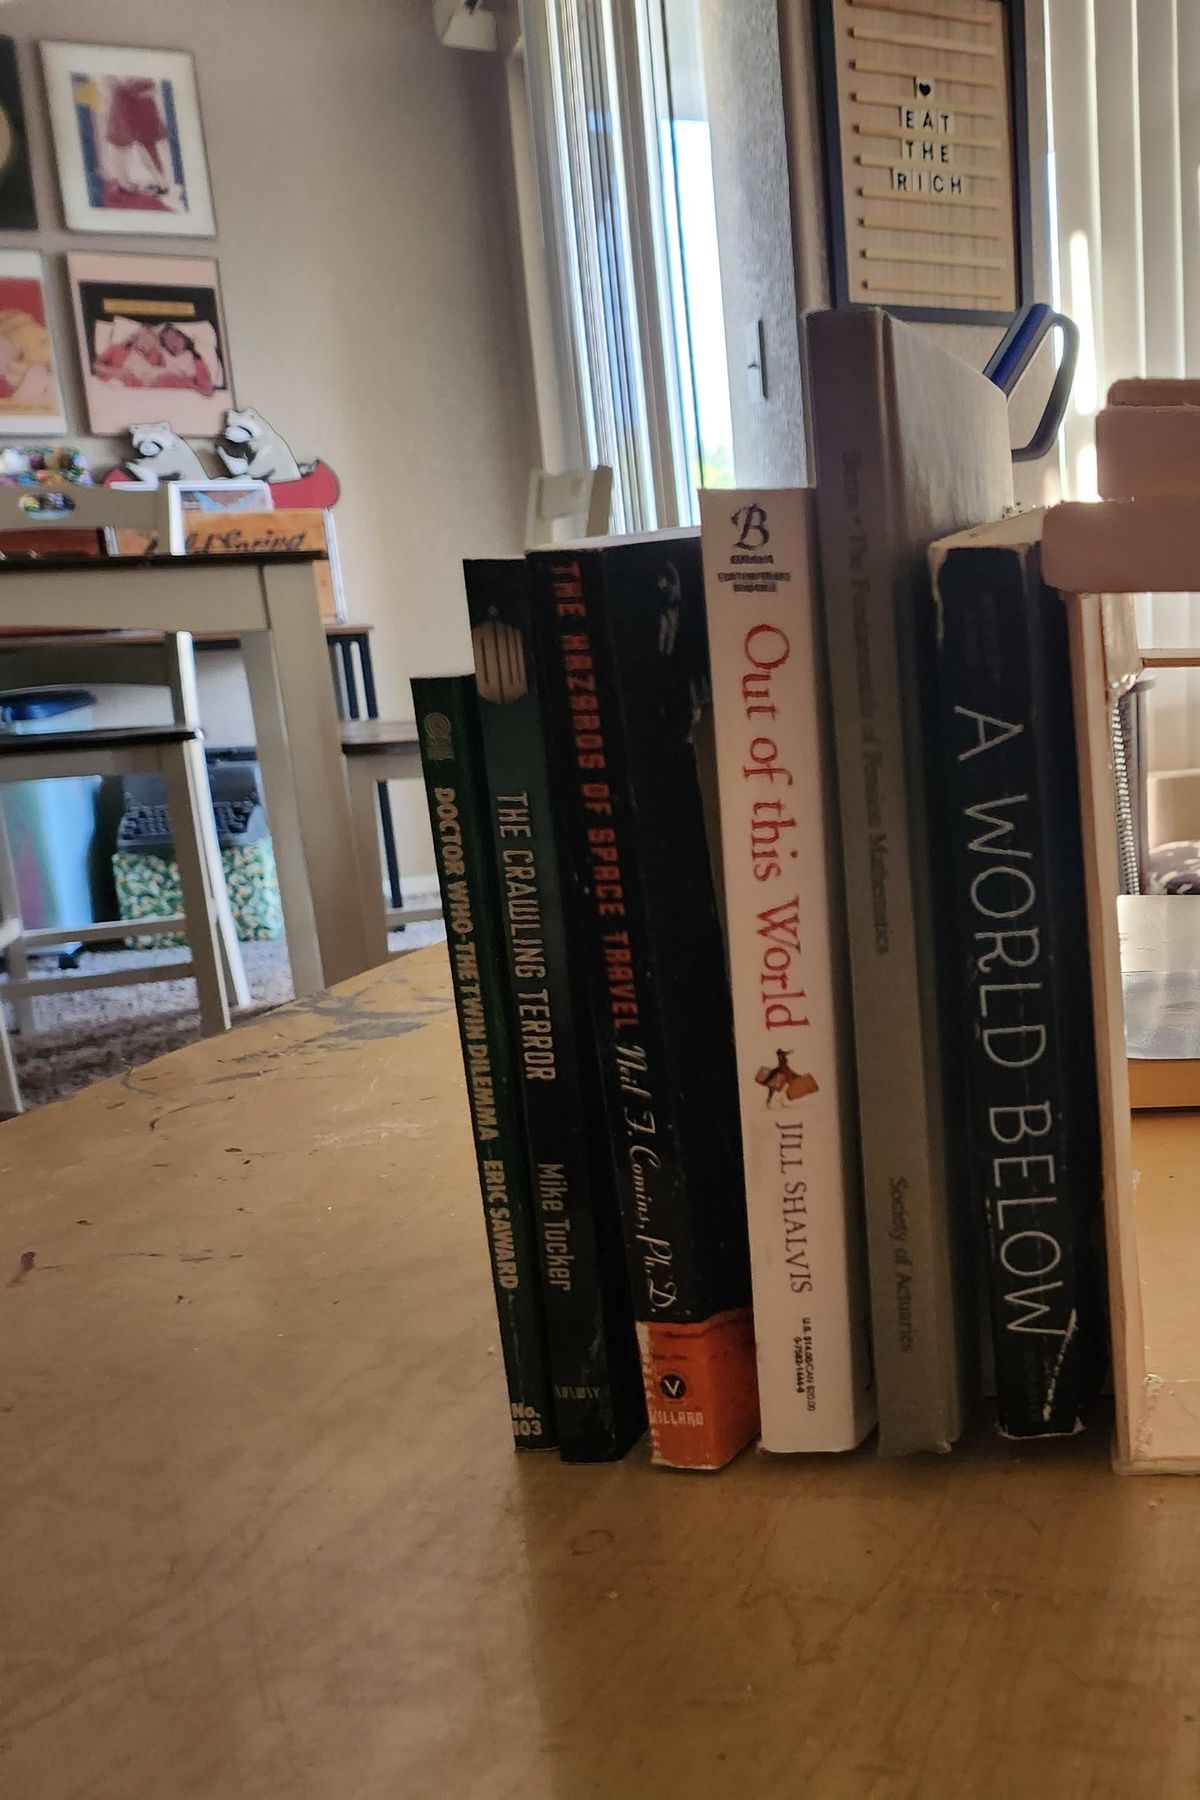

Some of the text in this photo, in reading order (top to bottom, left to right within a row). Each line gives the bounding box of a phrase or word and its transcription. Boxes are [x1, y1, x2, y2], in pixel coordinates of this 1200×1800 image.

[906, 110, 949, 132] EAT
[906, 140, 950, 163] THE
[897, 172, 962, 194] RICH
[741, 623, 790, 721] Out
[552, 561, 640, 1030] THE HAZARDS OF SPACE TRAVEL
[742, 737, 793, 786] of
[434, 786, 465, 876] DOCTOR
[751, 799, 798, 882] this
[497, 791, 557, 1081] THE CRAWLING TERROR
[756, 895, 810, 1031] World
[460, 982, 487, 1040] TWIN
[954, 704, 1069, 1337] A WORLD BELOW
[467, 1043, 500, 1141] DILEMMA
[616, 1044, 652, 1098] Neil
[483, 1159, 508, 1204] ERIC
[629, 1145, 662, 1229] Comins,
[775, 1121, 813, 1294] JILL SHALVIS
[488, 1204, 519, 1289] SAWARD
[538, 1163, 576, 1292] Mike Tucker
[894, 1248, 913, 1266] of
[511, 1402, 542, 1419] No.
[650, 1408, 705, 1427] VILLARD
[664, 1379, 681, 1396] V
[512, 1419, 543, 1437] 103
